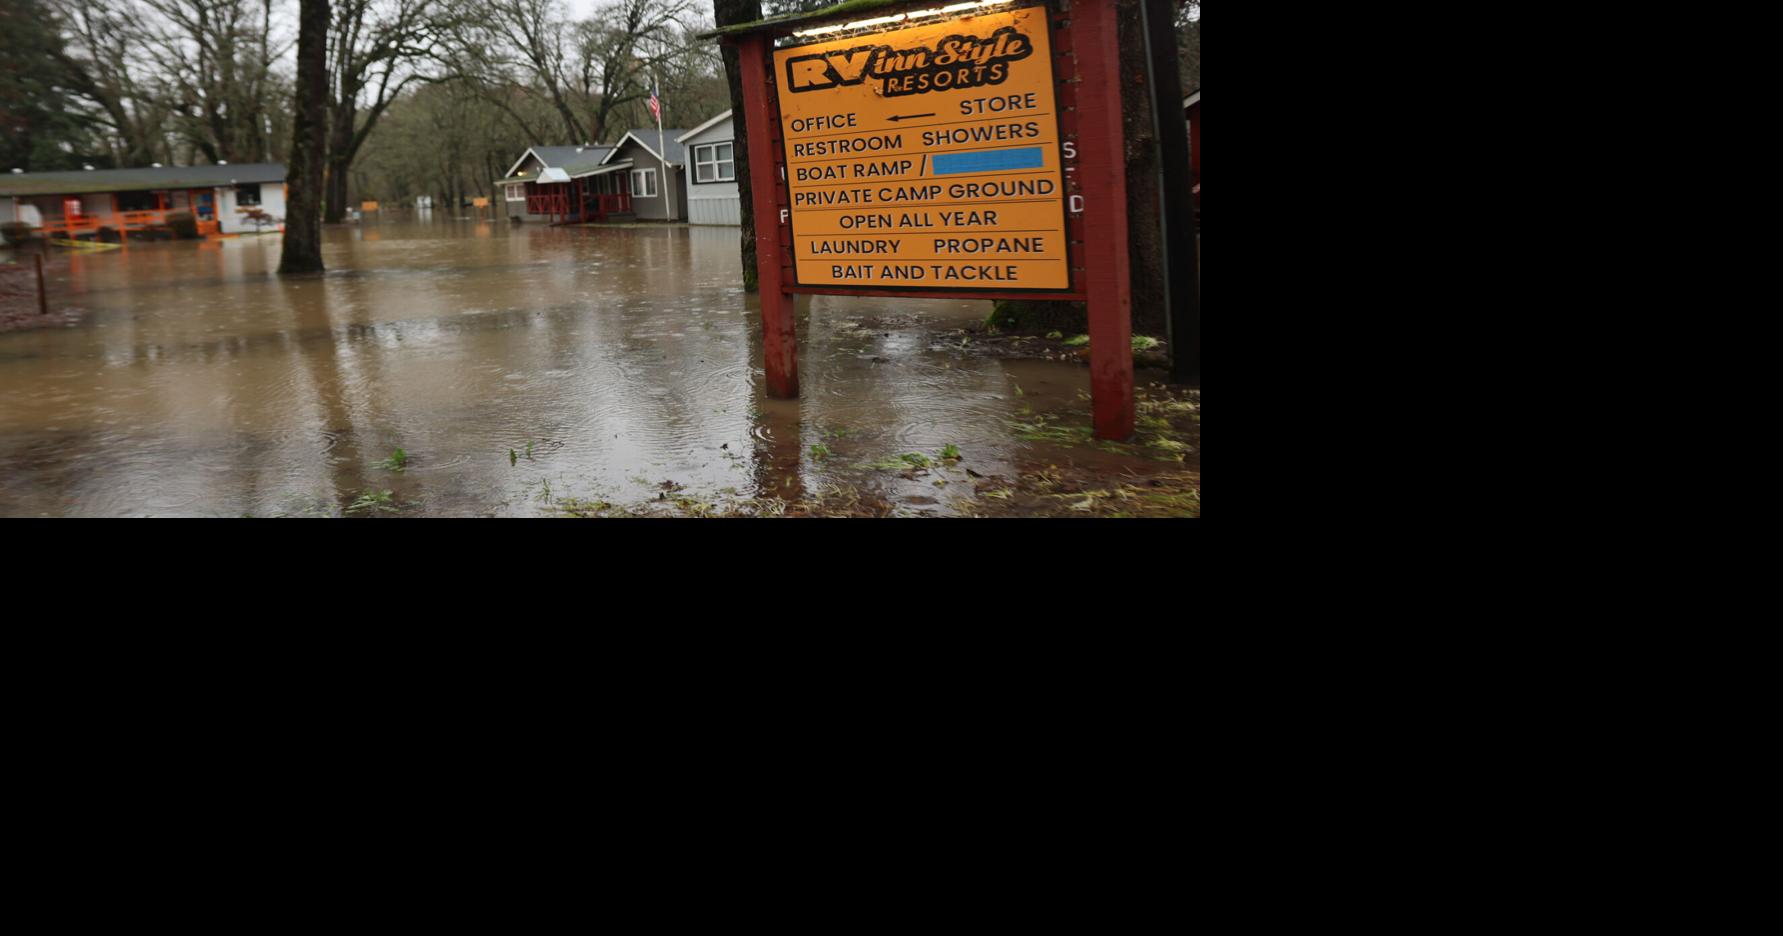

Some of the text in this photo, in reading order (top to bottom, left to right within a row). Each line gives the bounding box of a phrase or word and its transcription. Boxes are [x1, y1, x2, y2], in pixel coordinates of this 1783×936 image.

[790, 33, 1025, 88] RV inn Style
[887, 63, 1003, 93] RESORTS
[791, 93, 1037, 132] OFFICE STORE
[794, 122, 1040, 157] RESTROOM SHOWERS
[797, 165, 847, 181] BOAT
[853, 160, 912, 177] RAMP
[795, 179, 1055, 206] PRIVATE CAMP GROUND
[840, 210, 998, 229] OPEN ALL YEAR
[811, 237, 1044, 254] LAUNDRY PROPANE
[832, 265, 1018, 280] BAIT AND TACKLE
